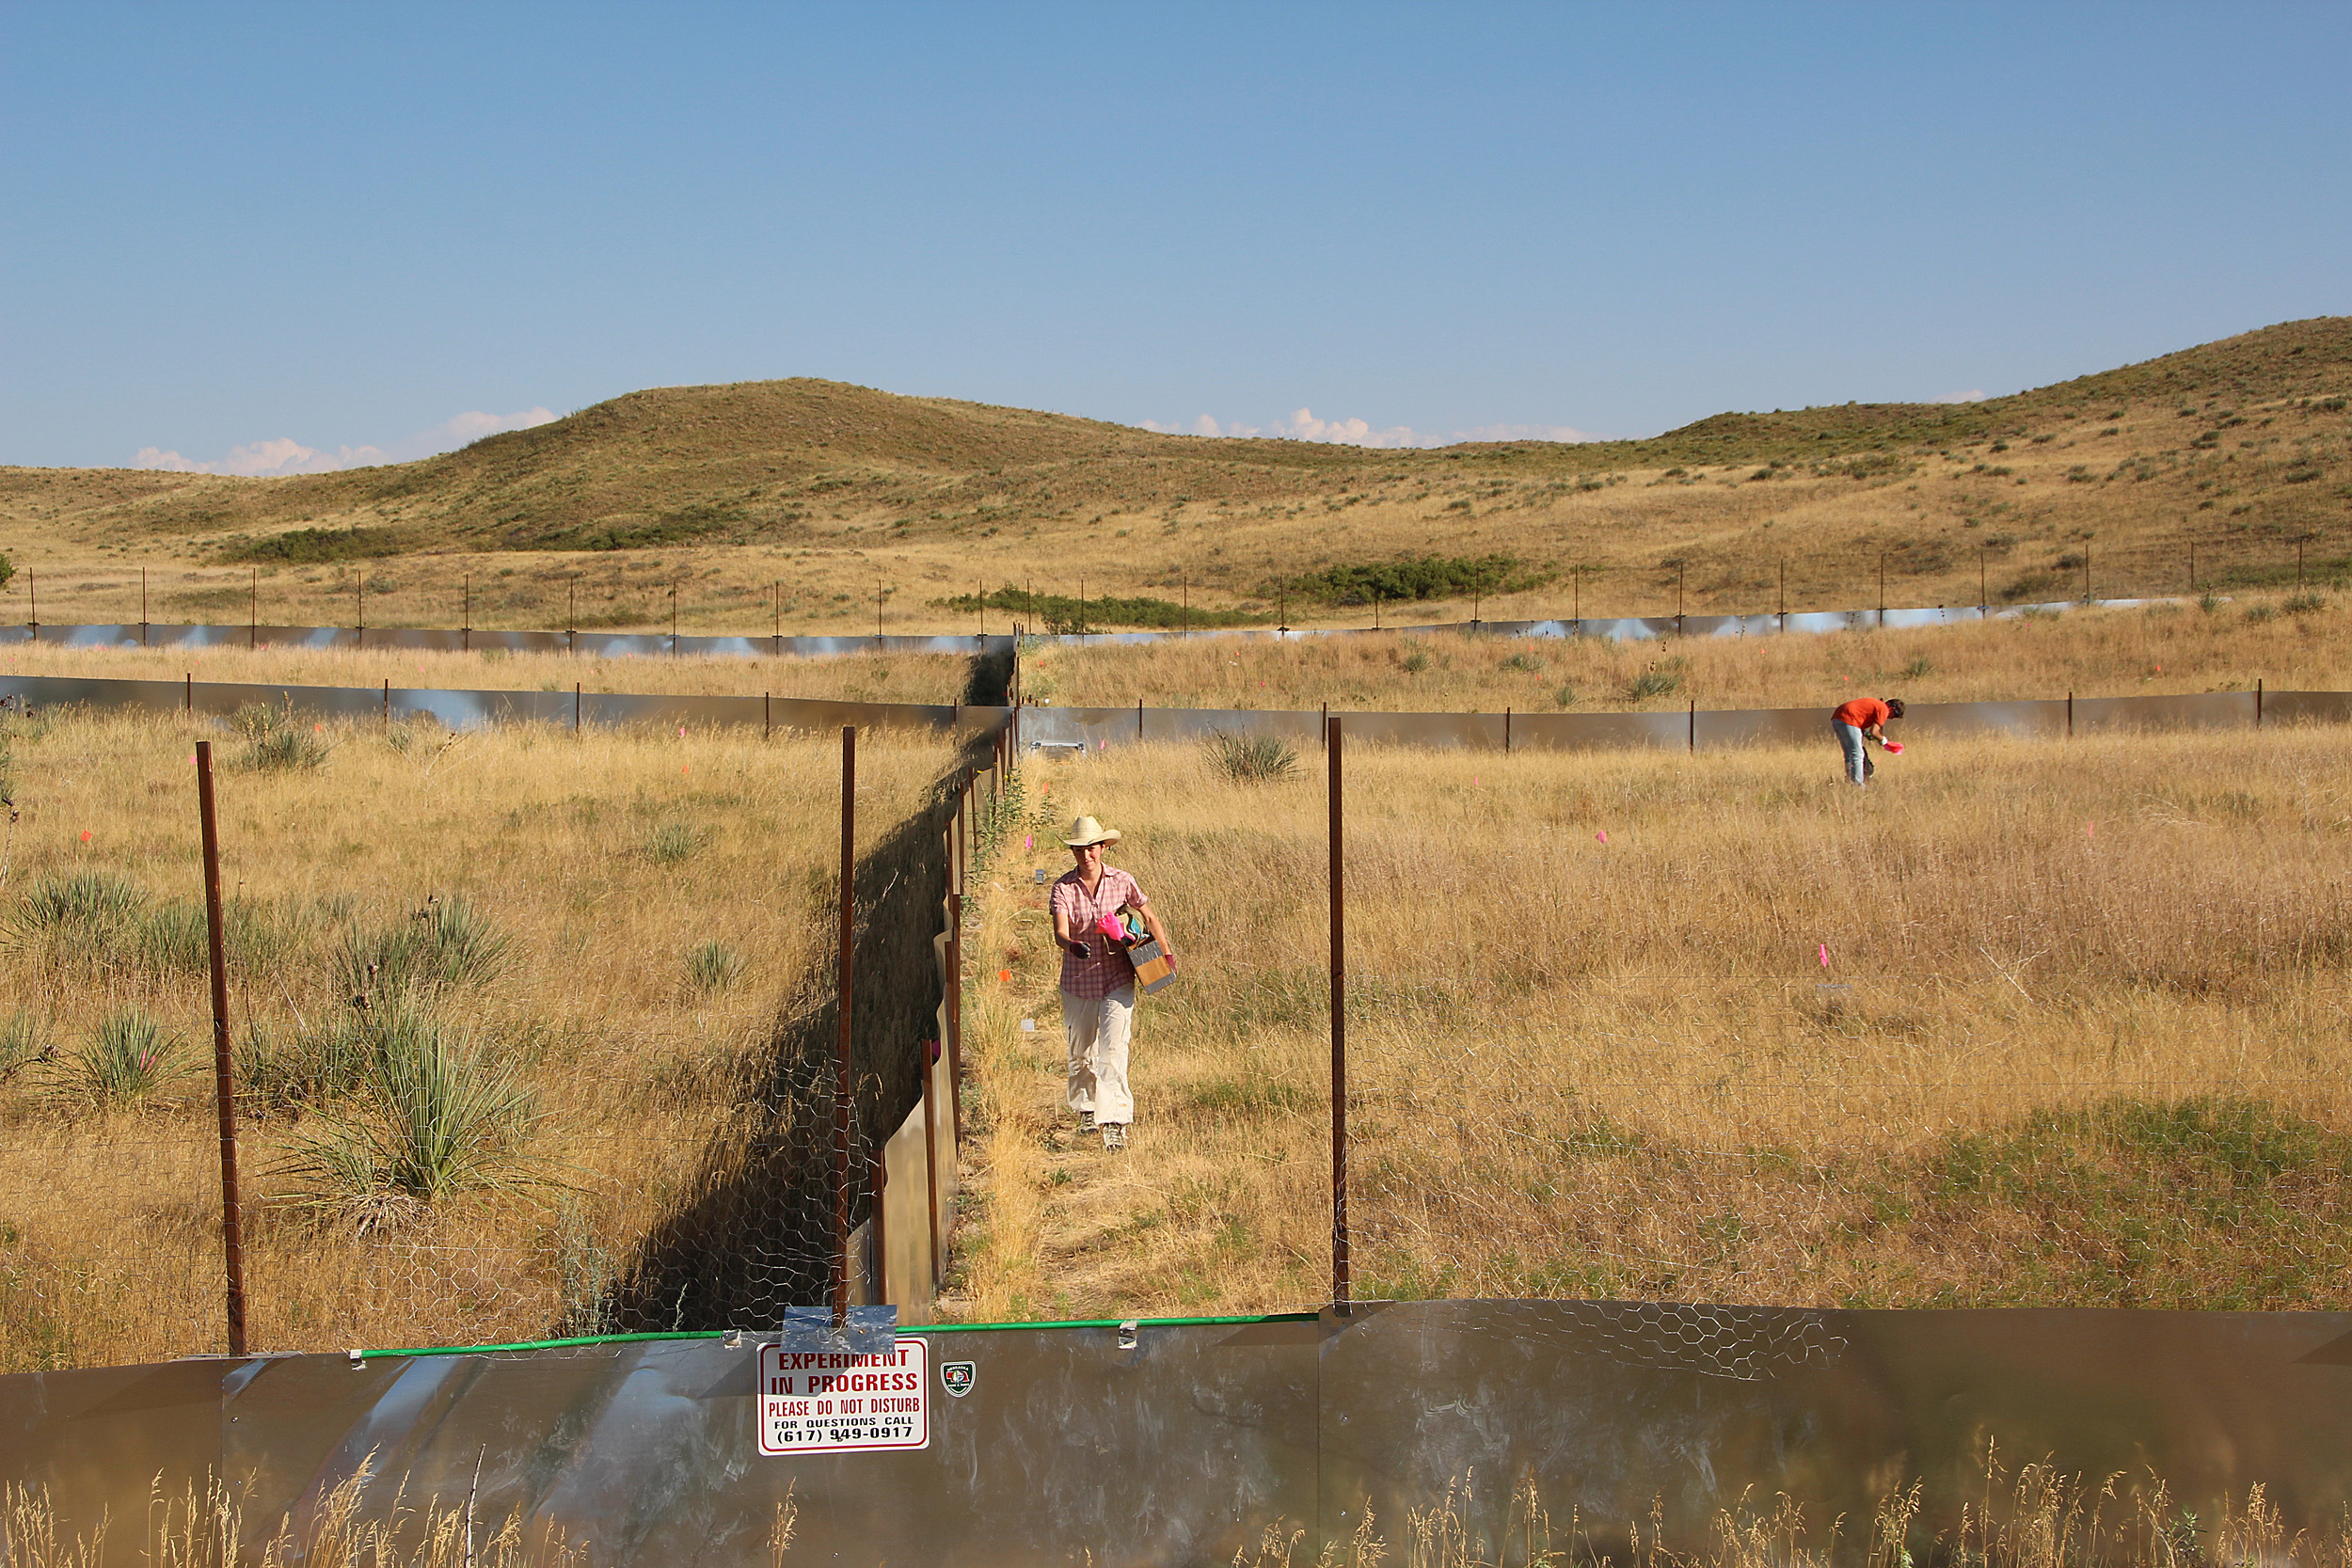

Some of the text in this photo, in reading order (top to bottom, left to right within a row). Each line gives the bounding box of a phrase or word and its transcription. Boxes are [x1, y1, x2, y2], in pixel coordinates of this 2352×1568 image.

[779, 1349, 909, 1370] EXPERIMENT
[771, 1372, 917, 1395] IN PROGRESS
[769, 1397, 920, 1418] PLEASE DO NOT DISTURB
[774, 1417, 914, 1430] FOR QUESTIONS CALL
[777, 1427, 913, 1444] (617) 949-0917
